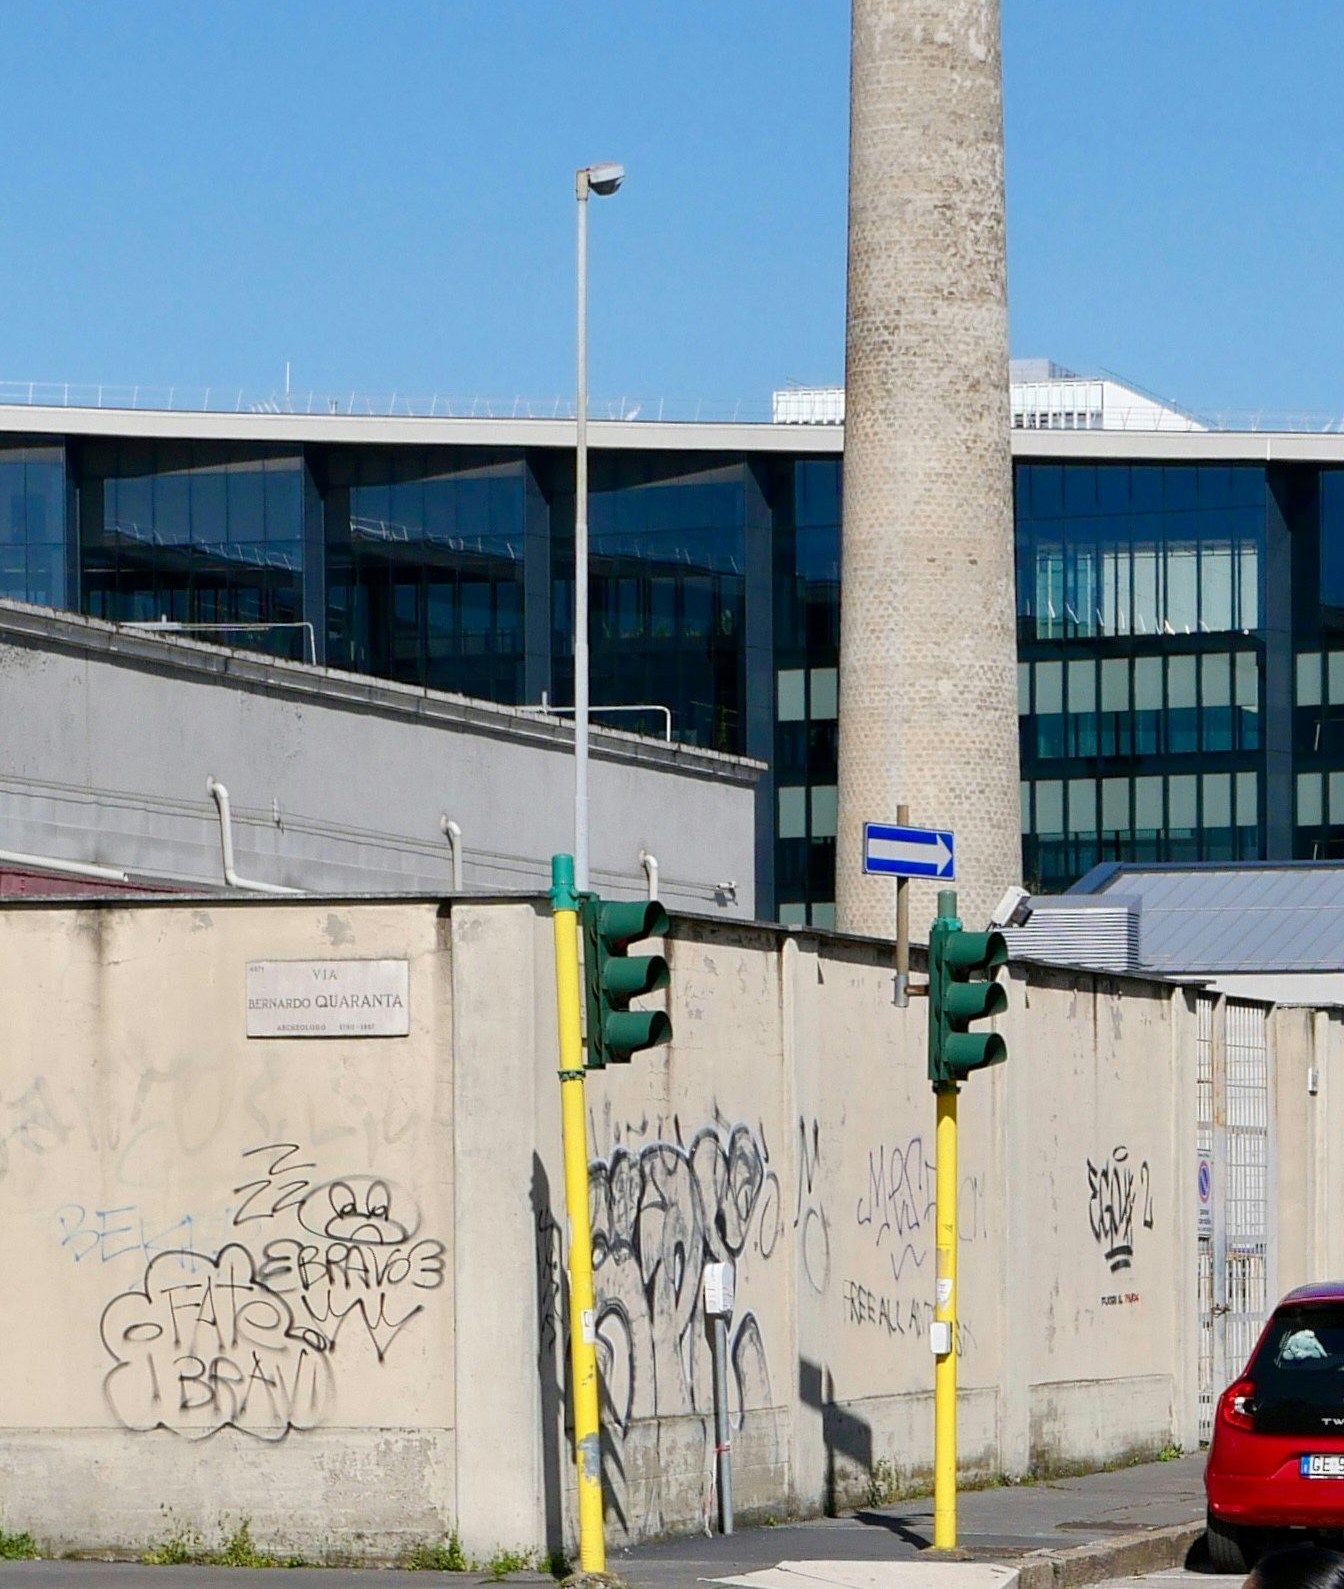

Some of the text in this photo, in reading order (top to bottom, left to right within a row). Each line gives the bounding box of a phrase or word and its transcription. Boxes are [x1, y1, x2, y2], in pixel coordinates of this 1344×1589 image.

[312, 969, 338, 980] VIA
[248, 993, 403, 1010] BERNARDO QUARANTA
[1311, 1455, 1331, 1472] GE
